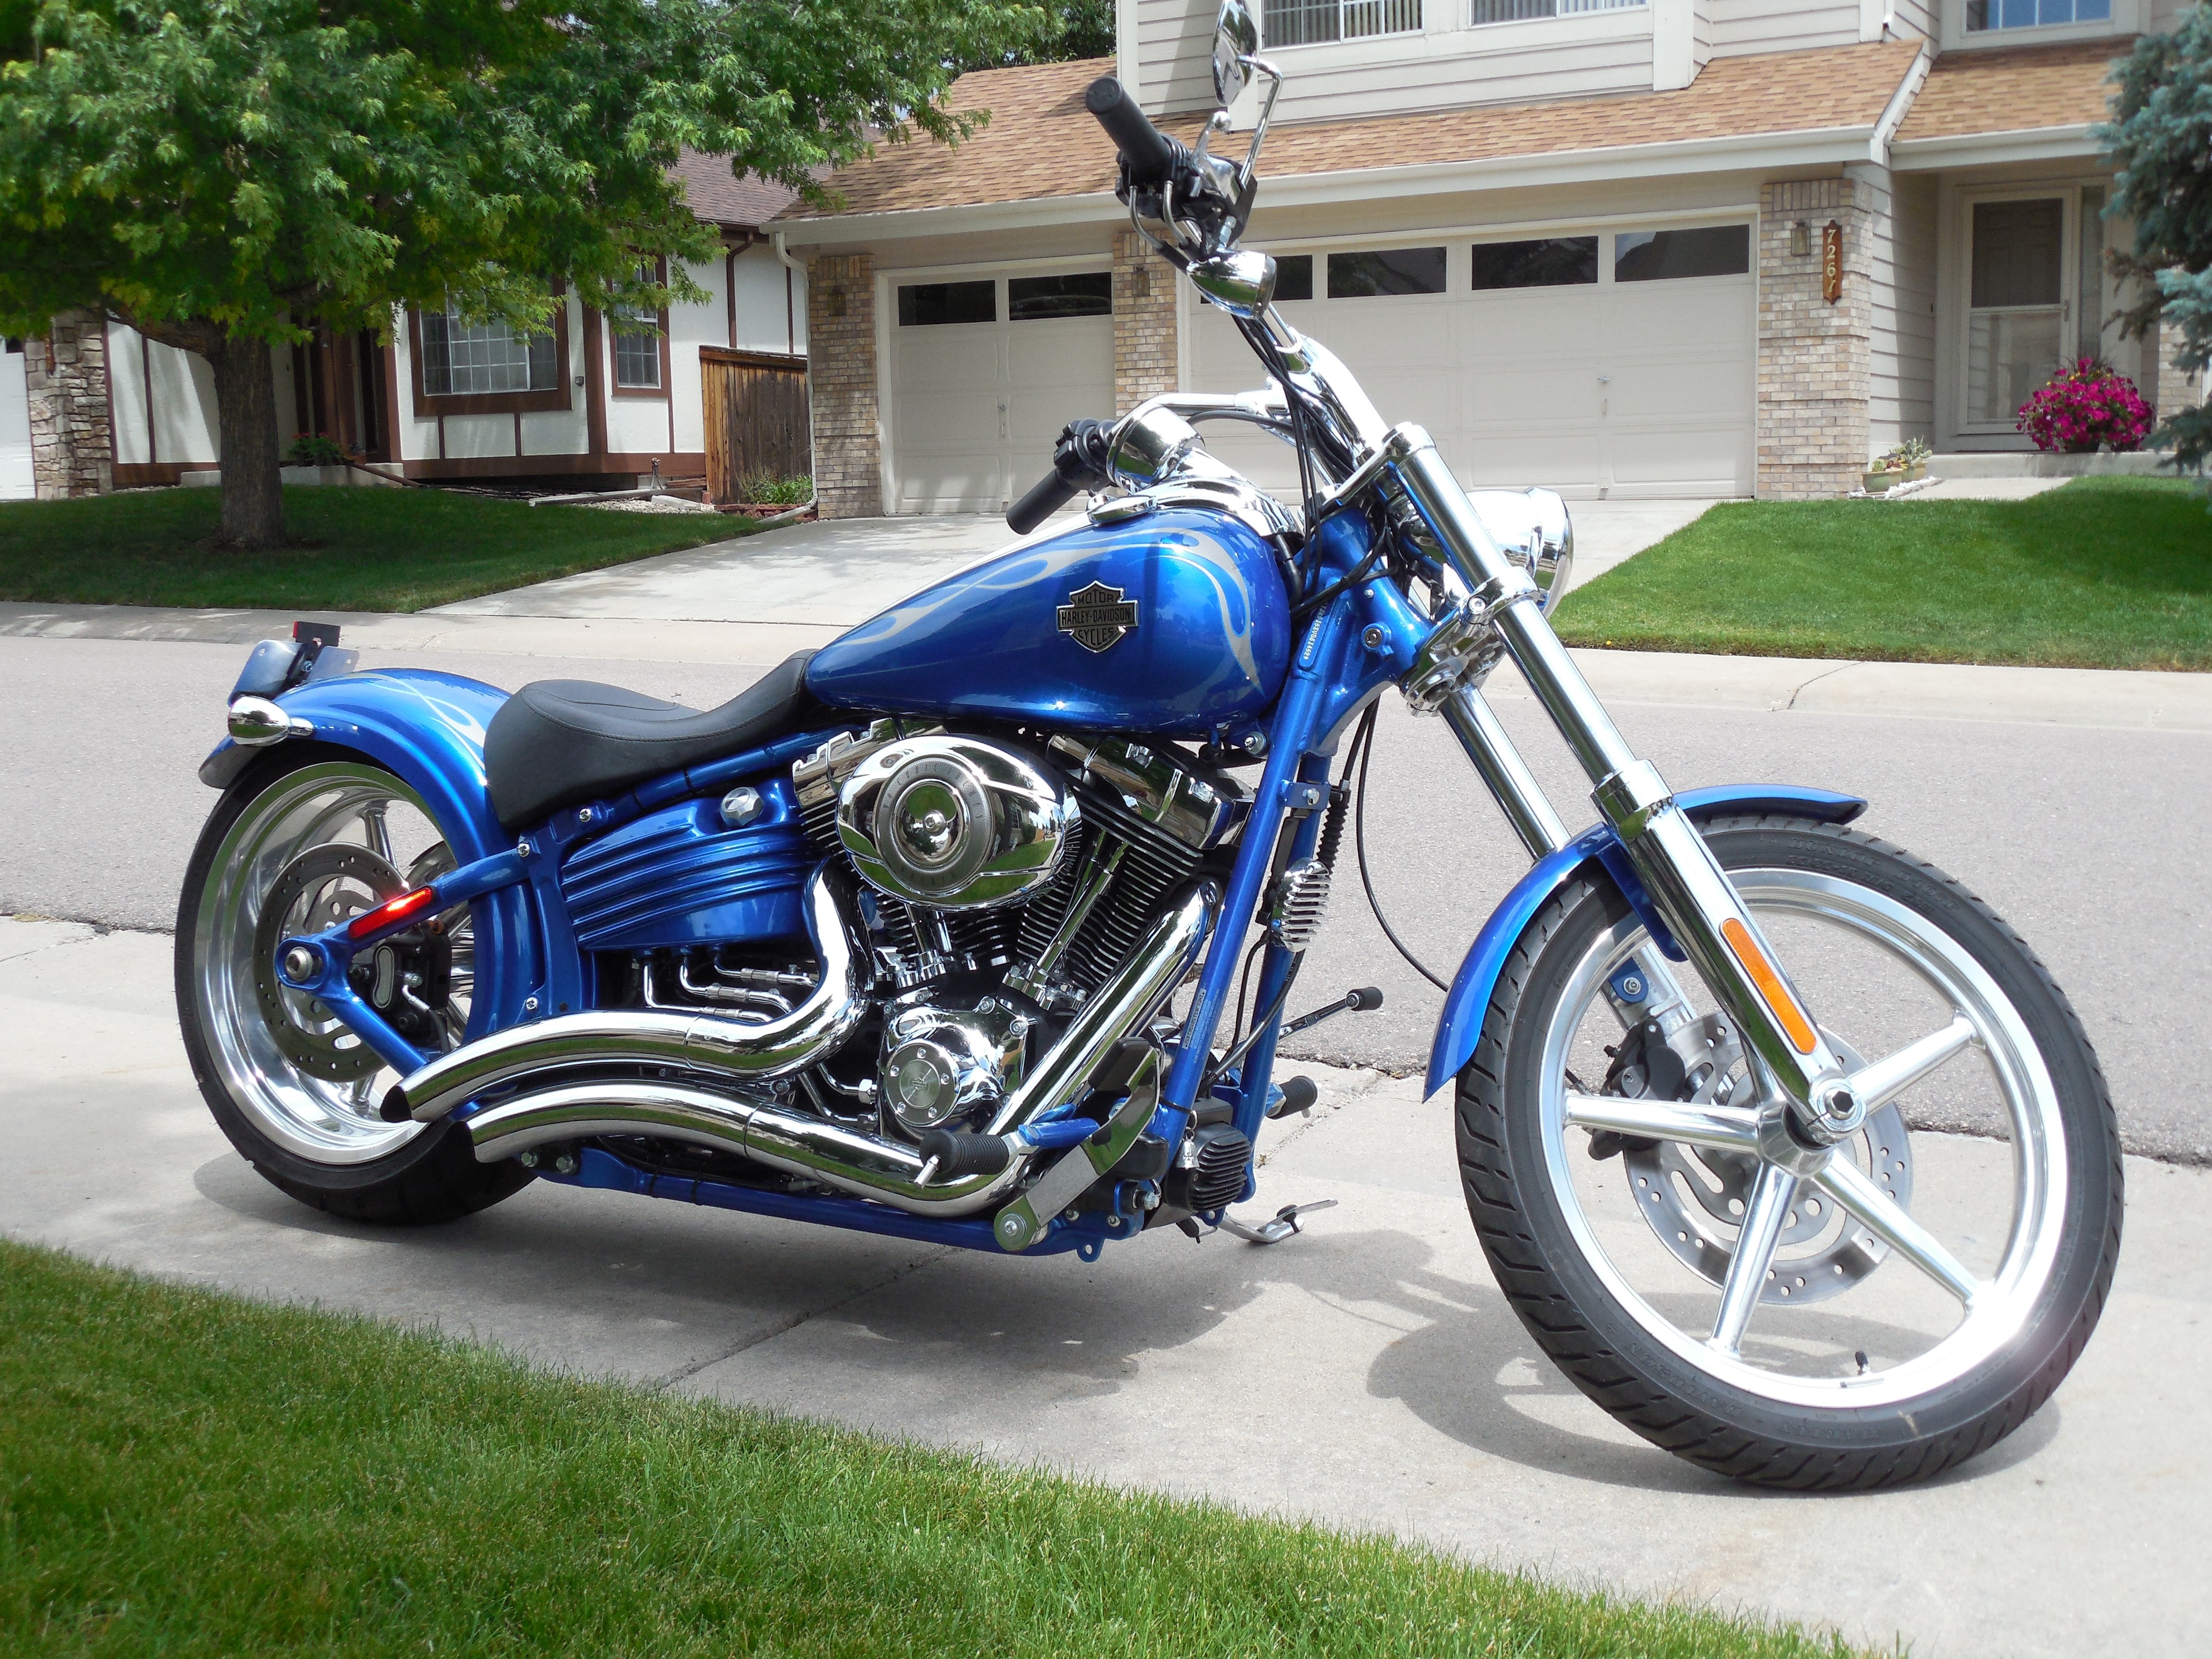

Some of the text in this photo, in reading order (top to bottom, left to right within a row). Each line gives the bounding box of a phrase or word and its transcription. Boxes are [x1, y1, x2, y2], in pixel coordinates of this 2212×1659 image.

[1826, 229, 1837, 292] 7261
[1077, 589, 1114, 605] MOTOR
[1061, 607, 1132, 625] HARLEY-DAVIDSON
[1078, 627, 1114, 646] CYCLES
[1788, 838, 1881, 866] DUNLOP
[1625, 1342, 1745, 1417] DAVIDSON
